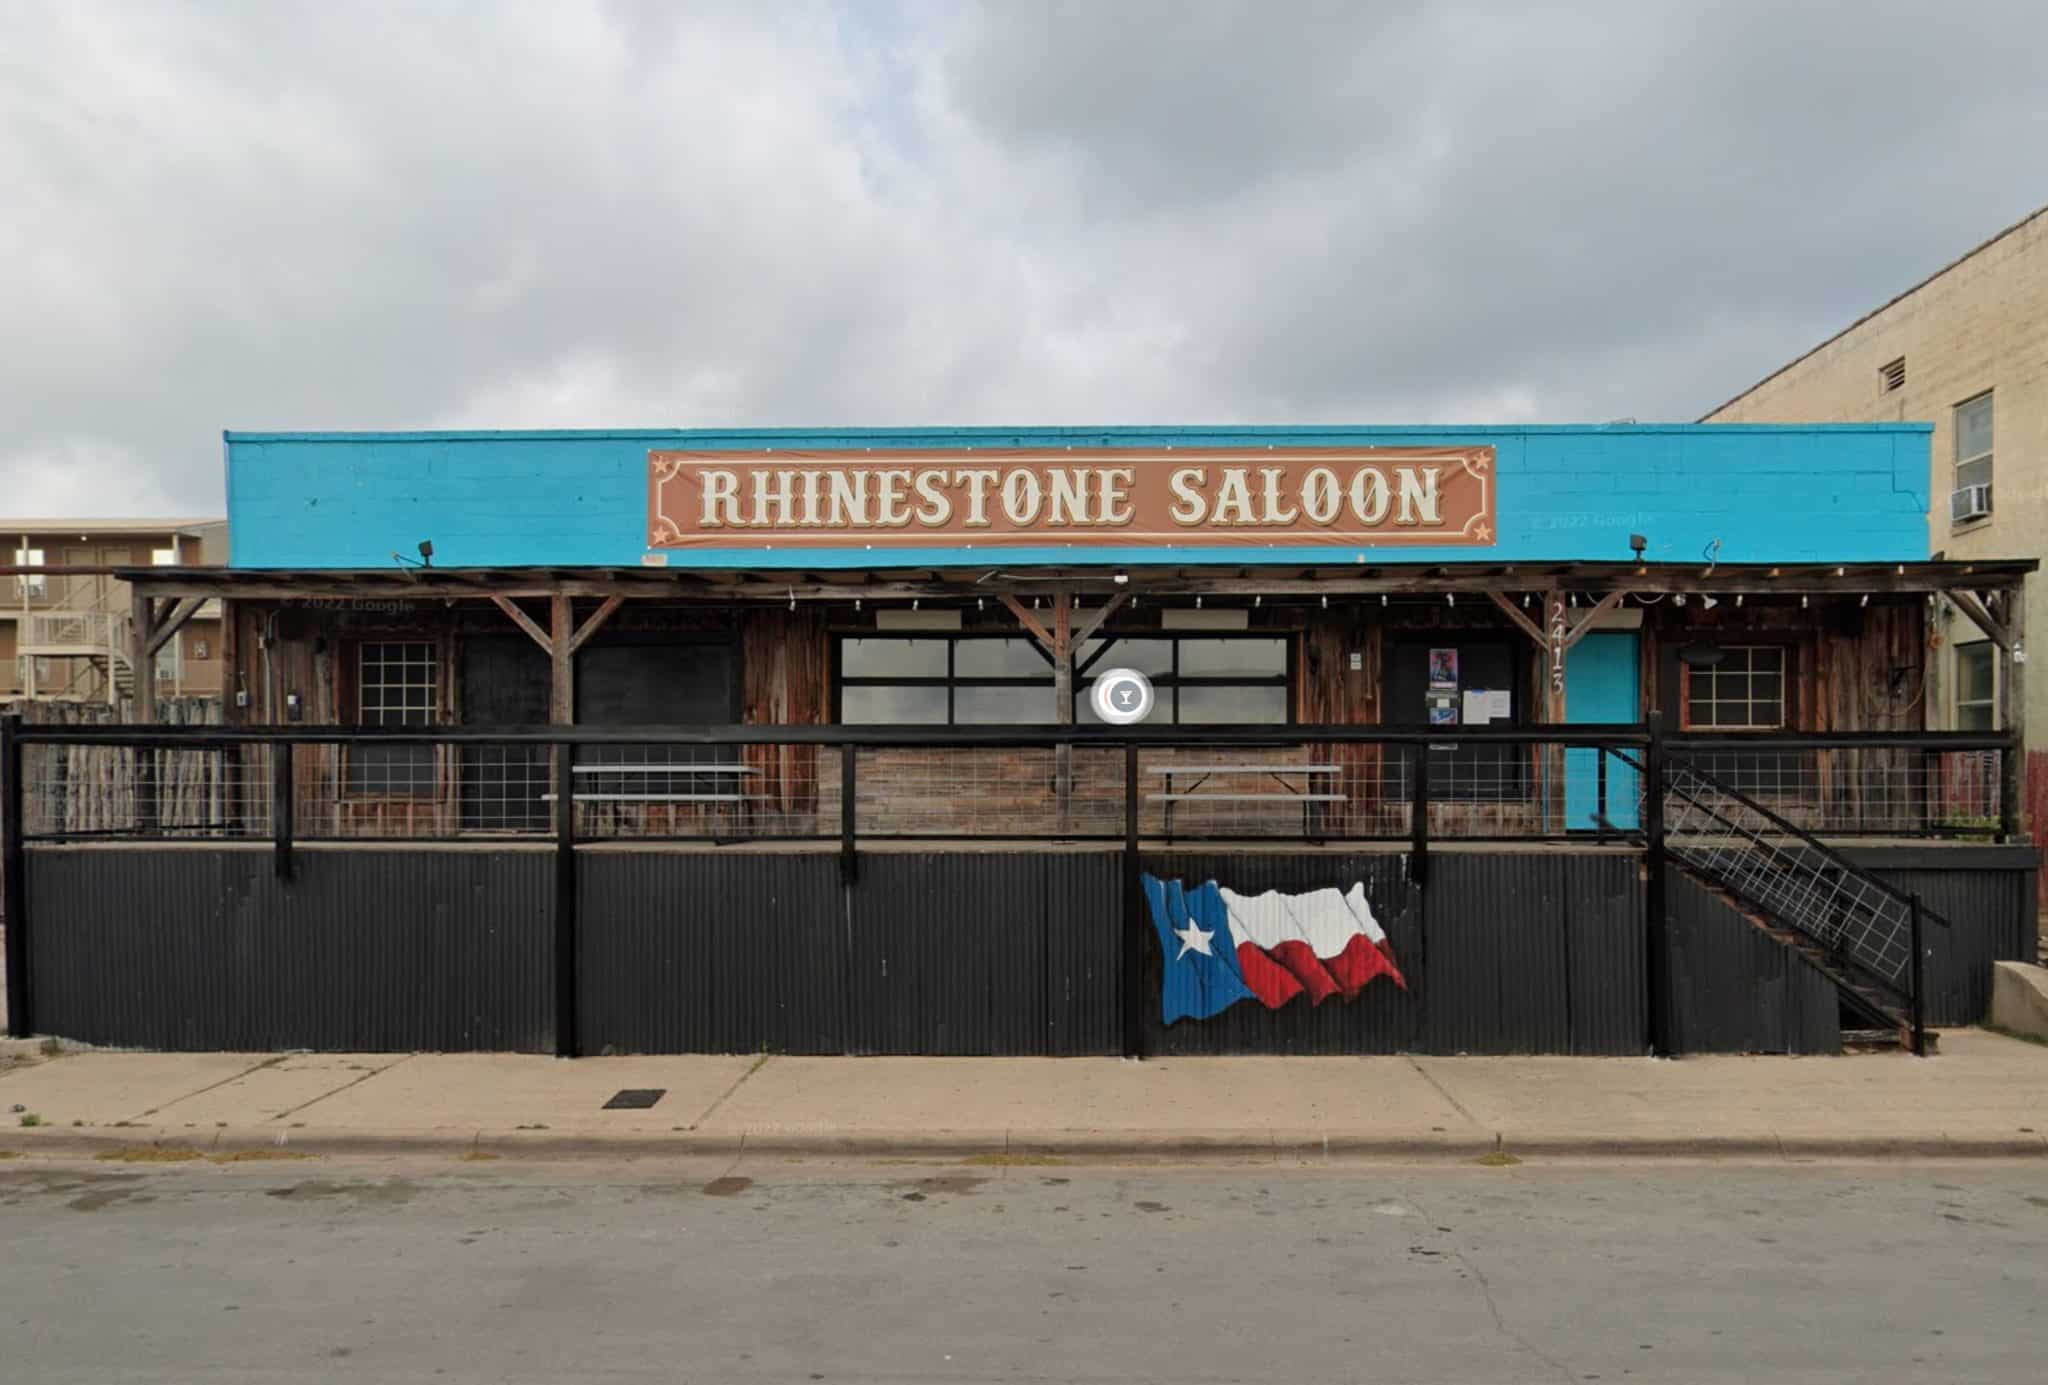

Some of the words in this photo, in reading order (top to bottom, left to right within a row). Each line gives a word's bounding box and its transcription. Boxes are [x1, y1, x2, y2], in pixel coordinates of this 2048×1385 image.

[697, 468, 1135, 527] RHINESTONE
[1169, 467, 1444, 526] SALOON
[1551, 601, 1563, 695] 2413
